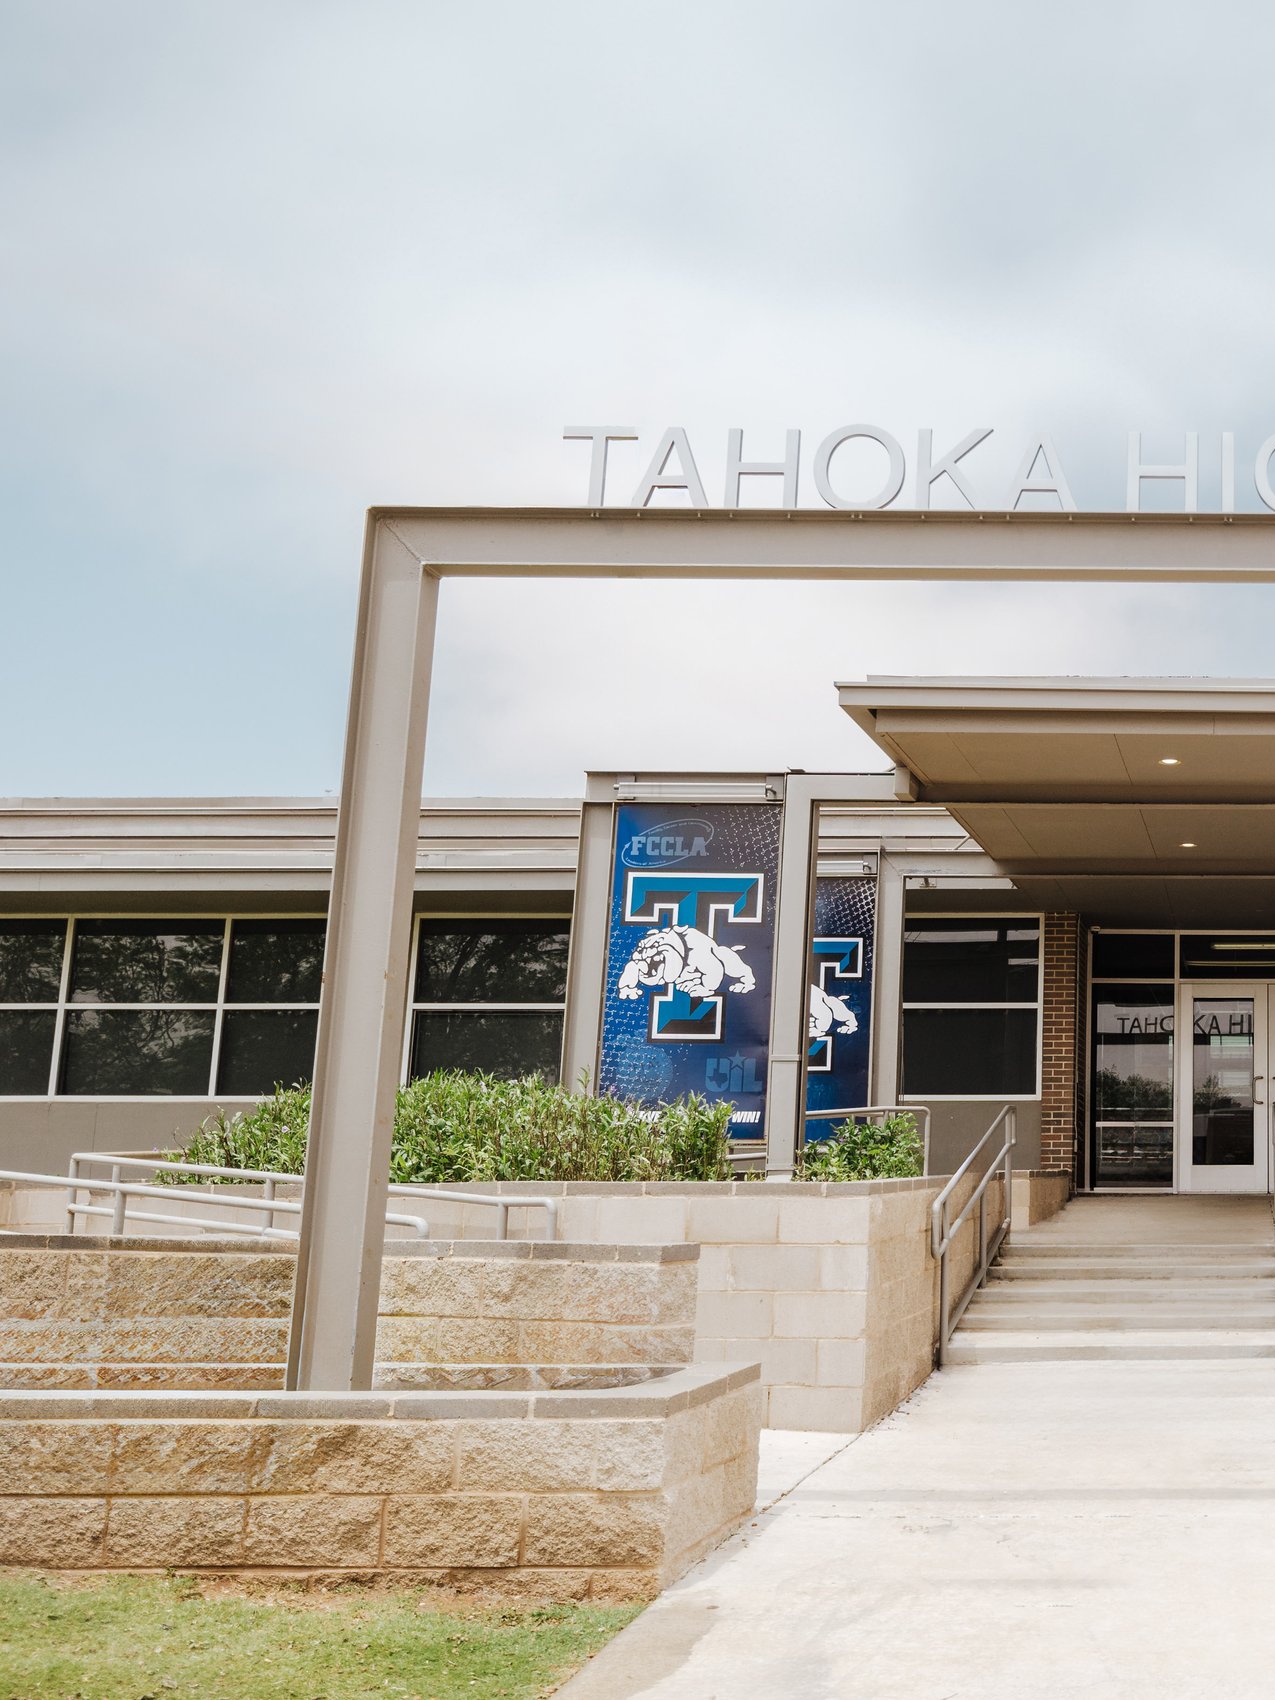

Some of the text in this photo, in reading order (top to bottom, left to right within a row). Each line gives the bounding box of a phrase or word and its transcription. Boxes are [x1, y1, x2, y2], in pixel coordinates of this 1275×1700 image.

[563, 423, 1079, 512] TAHOKA
[630, 836, 707, 857] FCCLA
[625, 872, 764, 1039] T
[731, 1111, 761, 1123] WIN!
